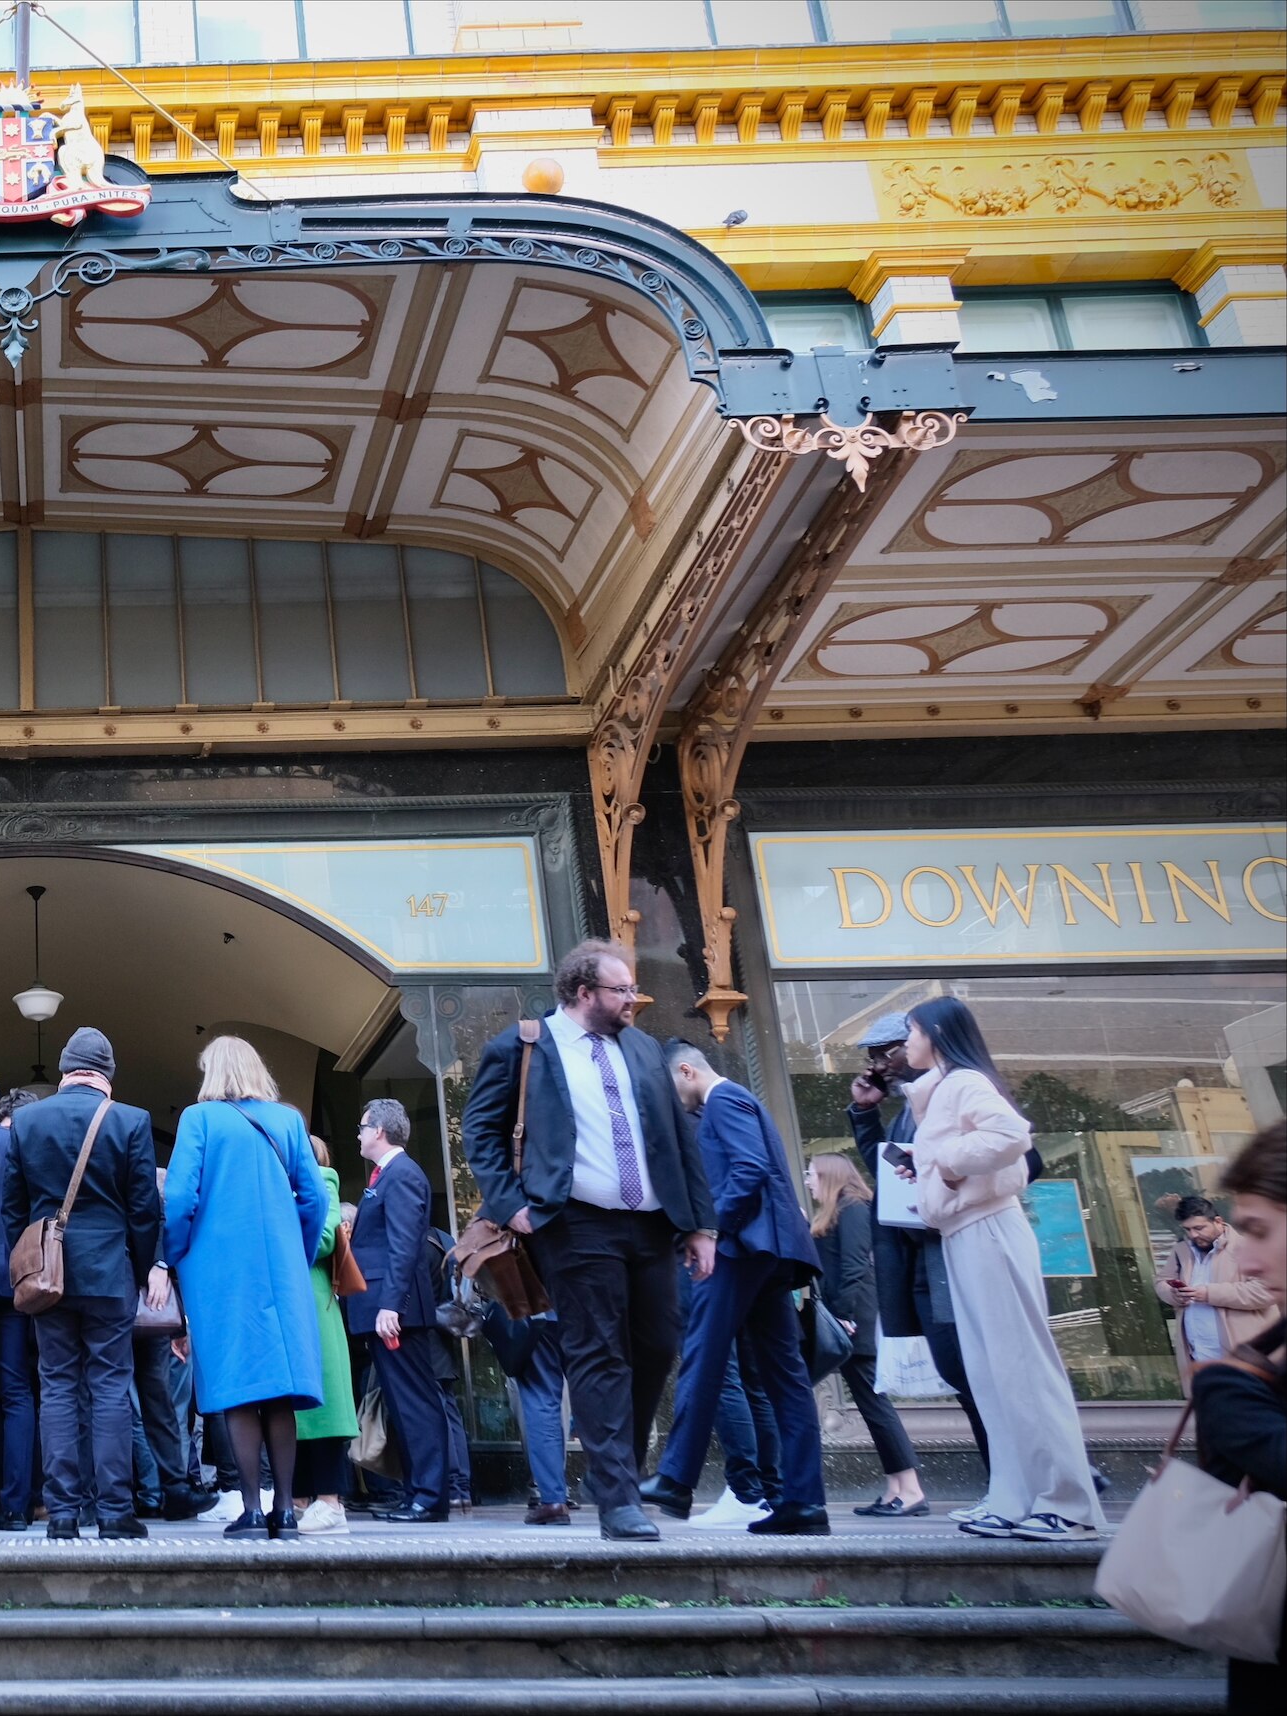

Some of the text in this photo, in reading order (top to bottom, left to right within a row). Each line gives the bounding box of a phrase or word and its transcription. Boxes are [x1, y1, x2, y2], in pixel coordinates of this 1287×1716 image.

[1, 204, 39, 214] QUAM
[54, 194, 89, 208] PURA
[98, 191, 137, 199] NITES
[406, 893, 448, 917] 147
